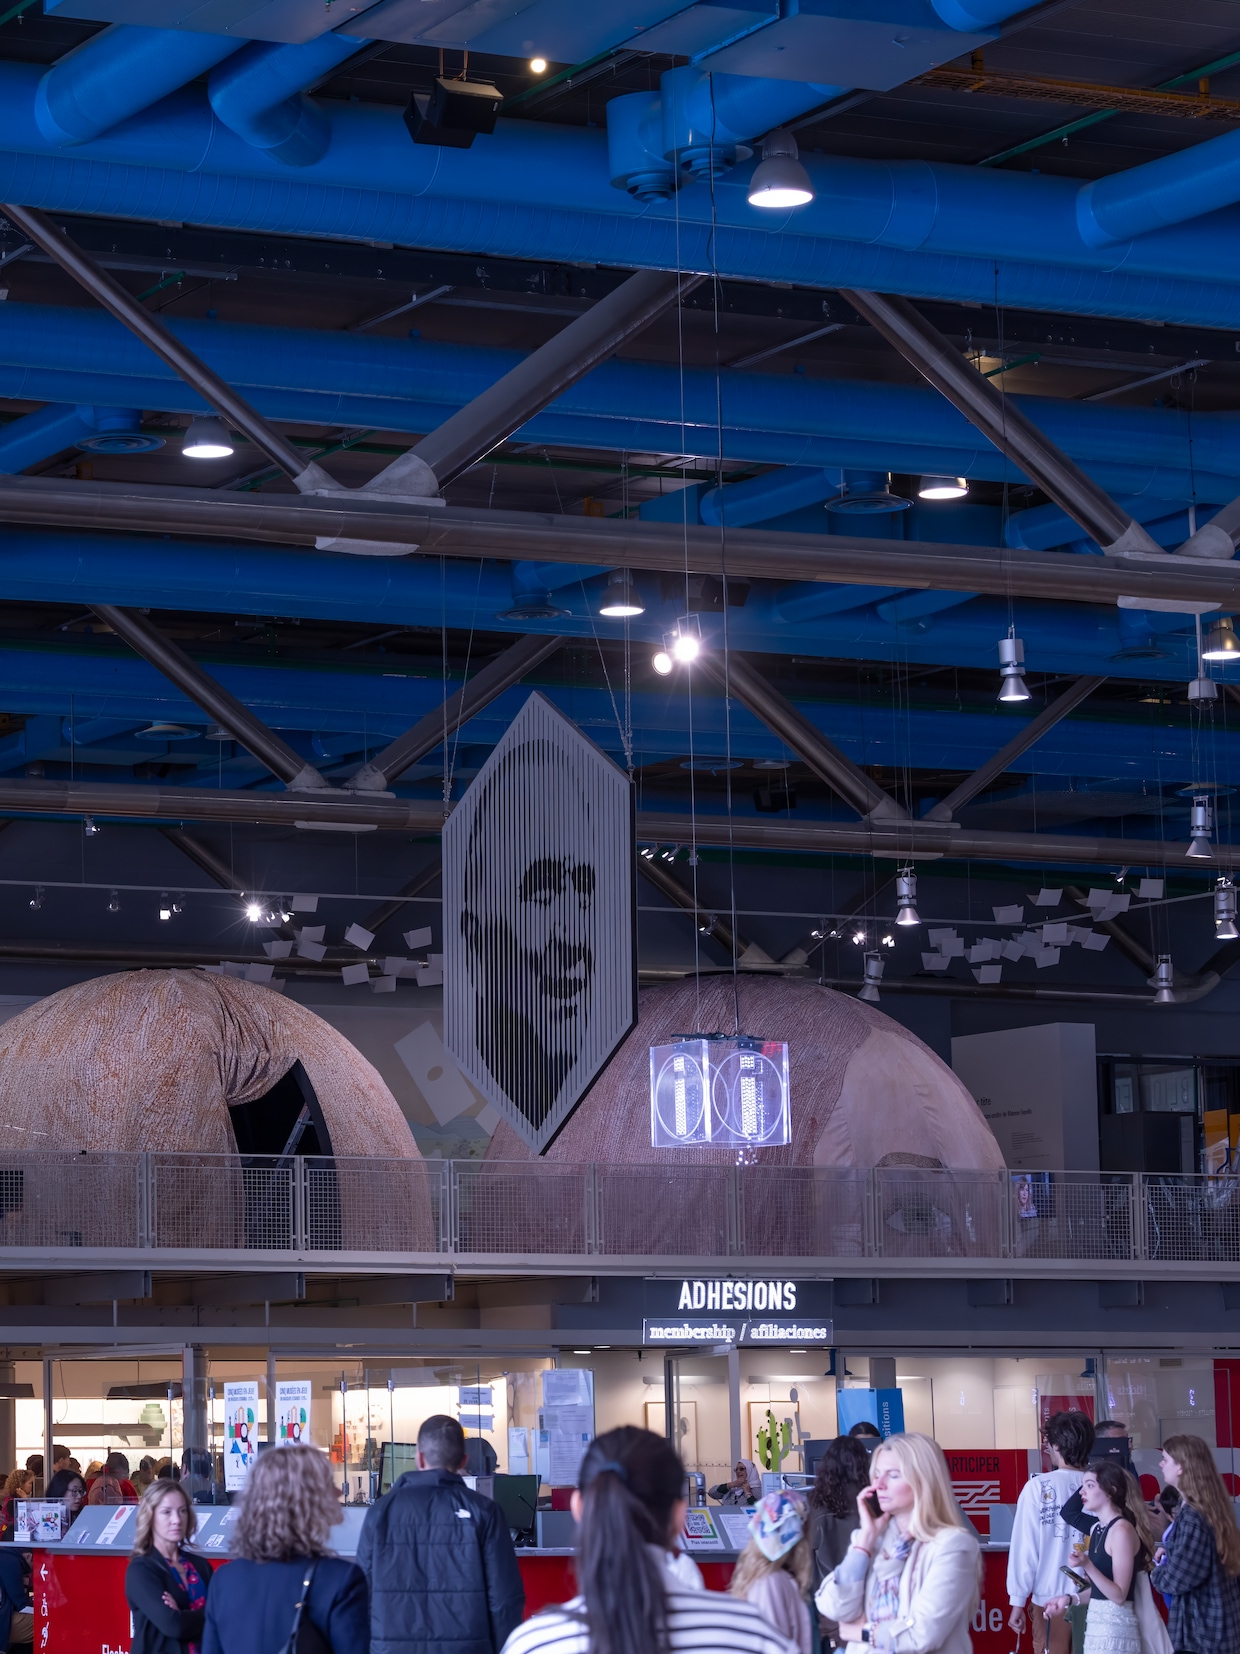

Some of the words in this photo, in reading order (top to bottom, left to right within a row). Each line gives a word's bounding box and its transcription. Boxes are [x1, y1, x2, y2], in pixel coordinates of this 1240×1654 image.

[678, 1281, 797, 1310] ADHESIONS
[649, 1324, 736, 1343] membership
[739, 1323, 747, 1342] /
[750, 1324, 827, 1340] afiliaciones
